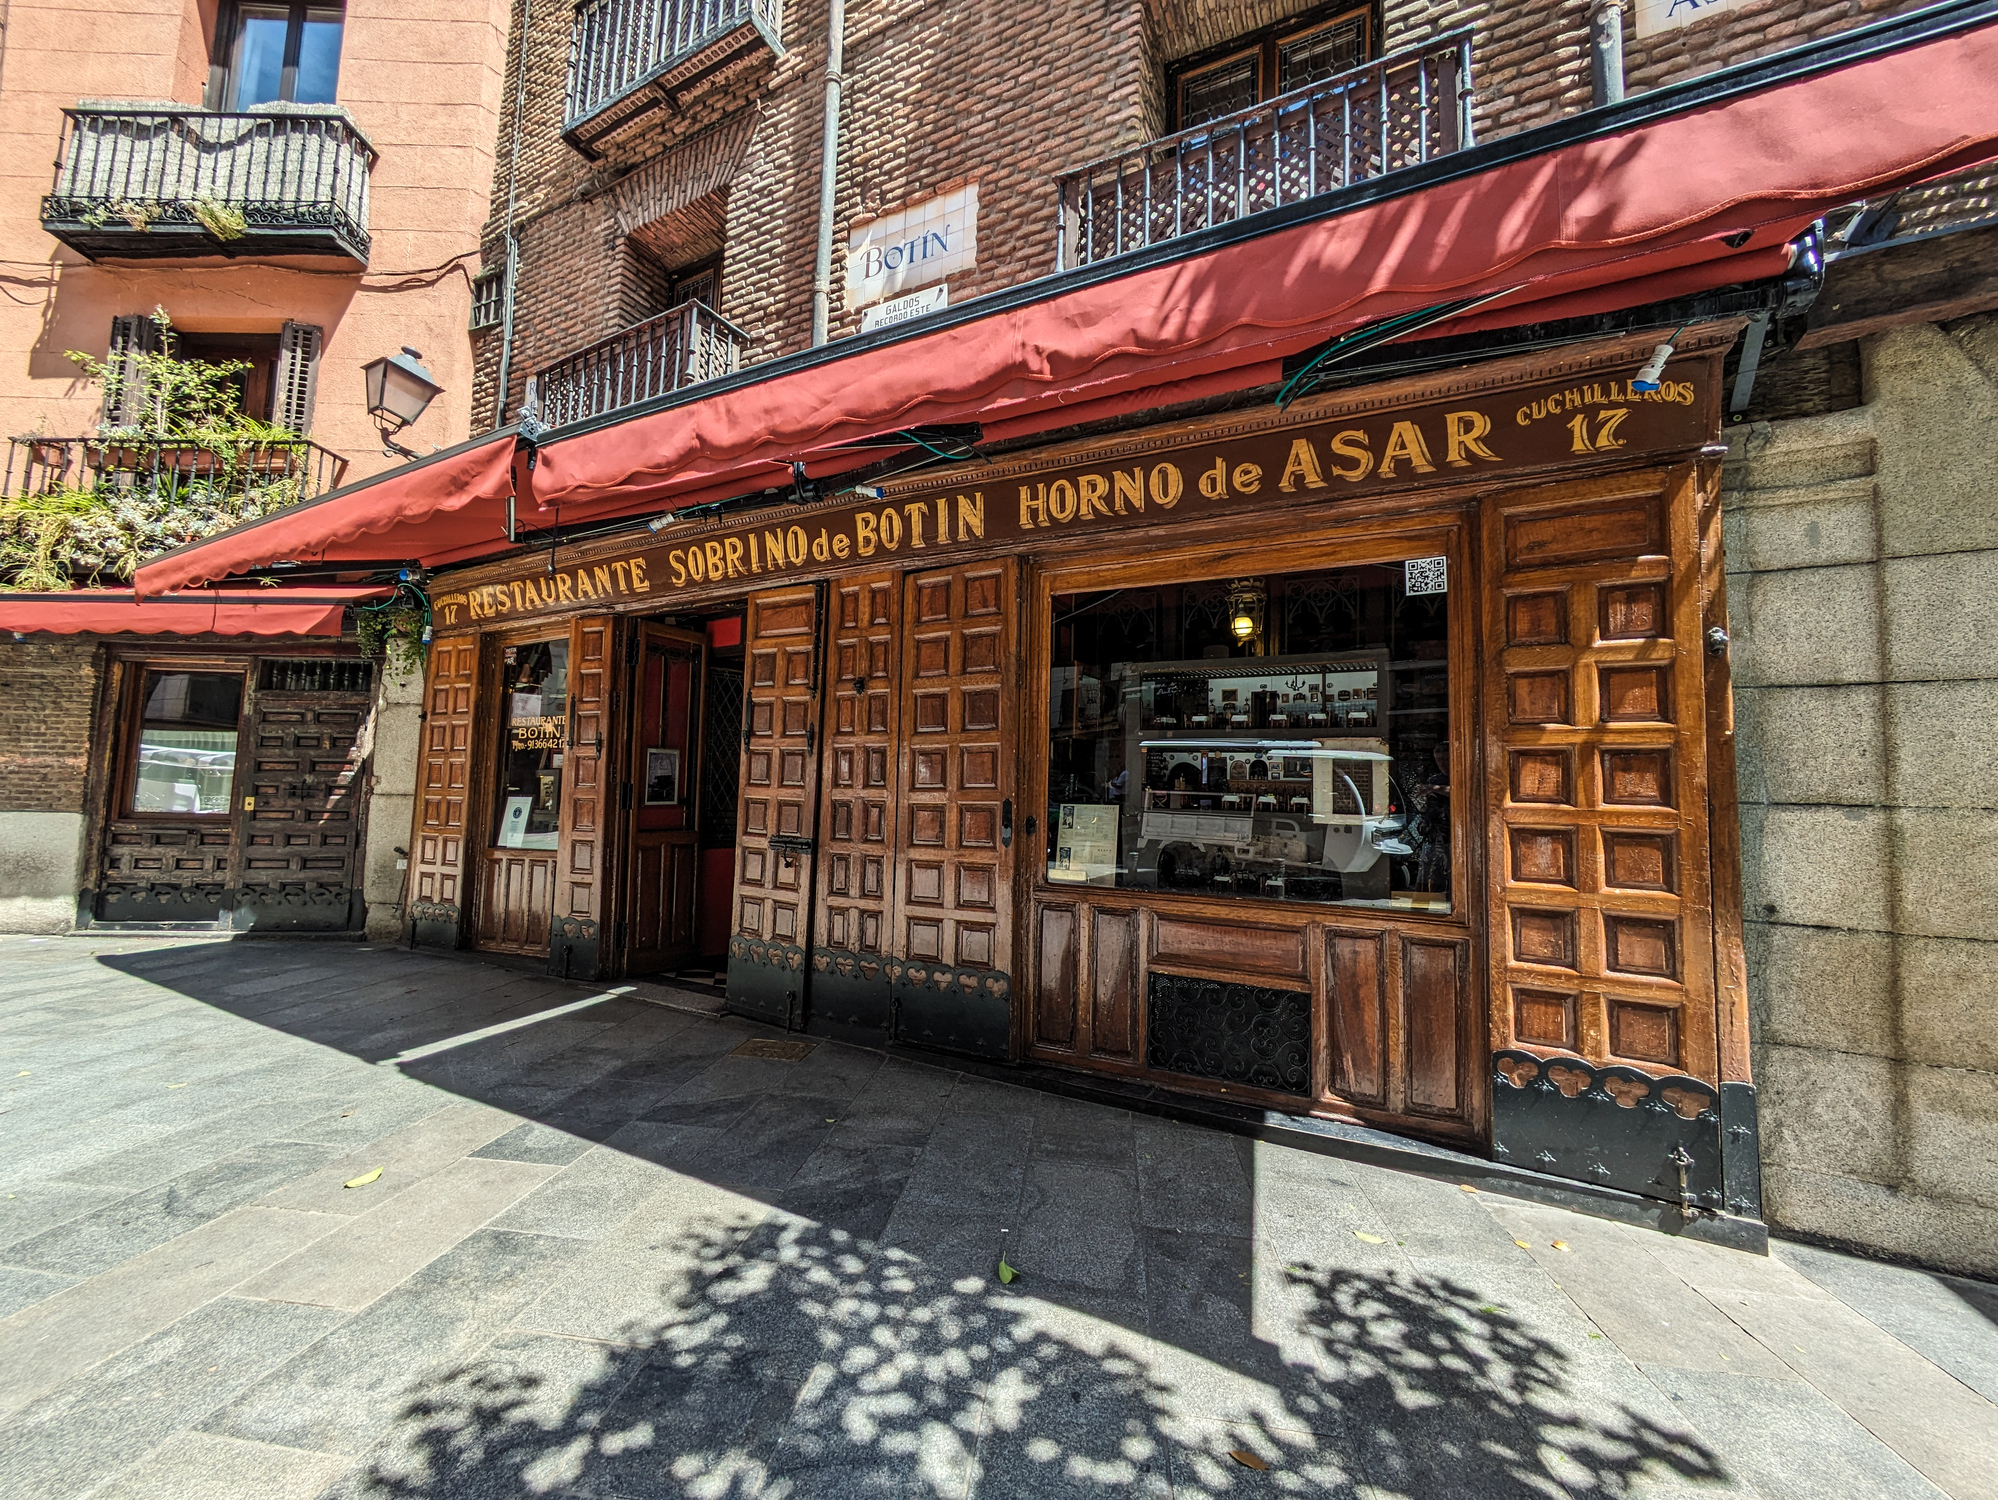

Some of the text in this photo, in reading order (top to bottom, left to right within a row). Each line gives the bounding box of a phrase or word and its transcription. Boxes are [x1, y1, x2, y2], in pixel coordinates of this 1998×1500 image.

[860, 224, 950, 281] BOTÍN
[885, 295, 920, 316] GALDOS
[909, 303, 931, 318] ESTE
[468, 410, 1504, 620] RESTAURANTE SOBRINO de BOTIN HORNO de ASAR
[511, 715, 566, 727] RESTAURANTE
